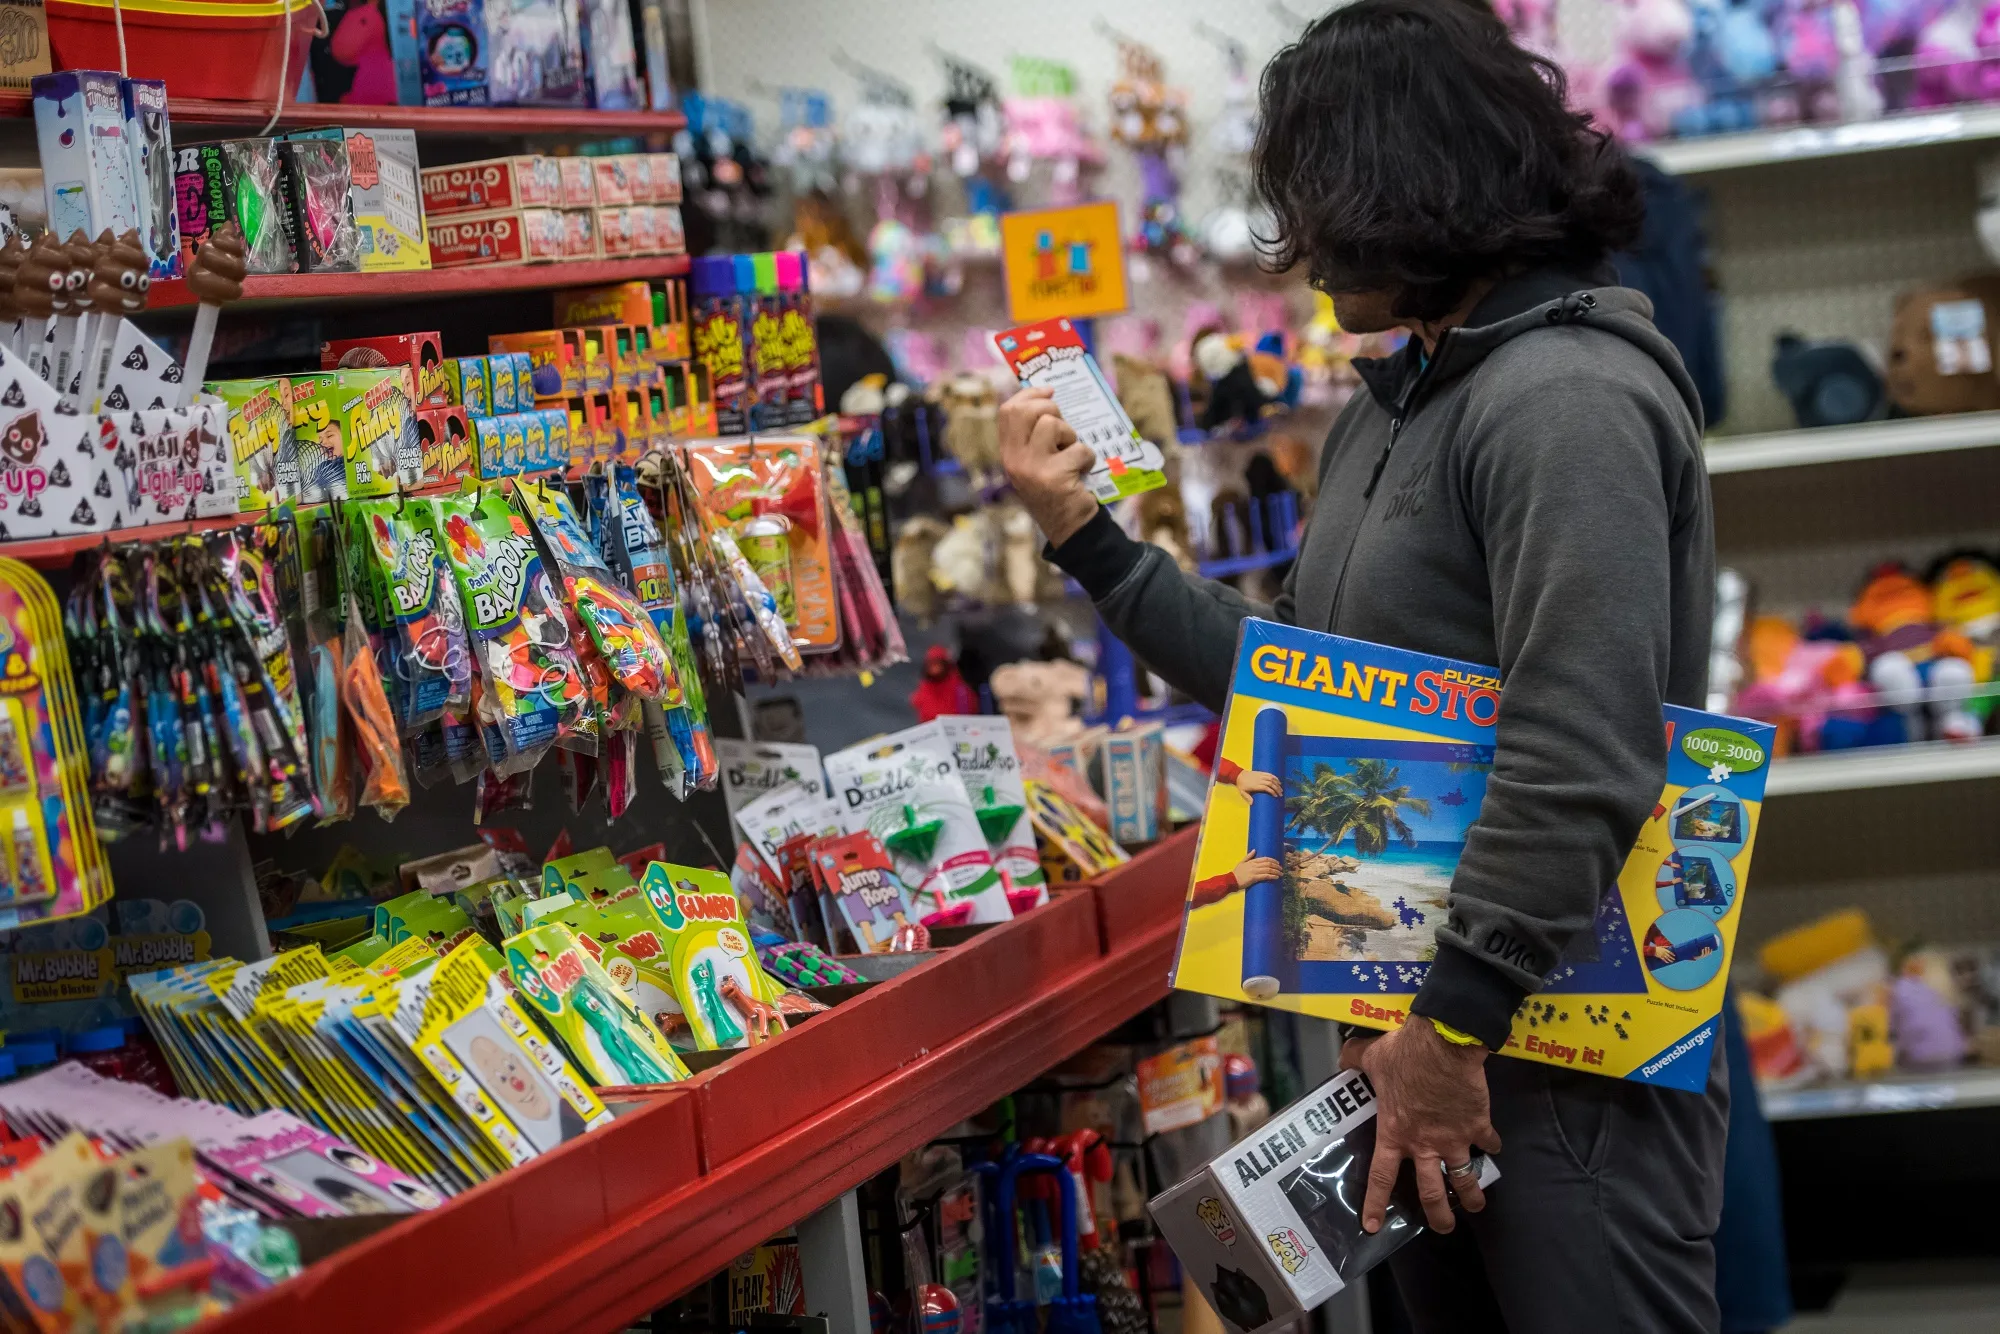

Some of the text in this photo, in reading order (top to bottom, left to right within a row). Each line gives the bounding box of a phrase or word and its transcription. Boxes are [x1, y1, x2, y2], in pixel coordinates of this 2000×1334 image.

[202, 147, 219, 157] The
[1015, 345, 1085, 380] Jump Rope
[322, 379, 332, 387] 5+
[342, 395, 363, 413] ORIGINAL
[347, 404, 400, 462] Slinky
[277, 461, 298, 473] GRAND
[355, 462, 367, 473] BIG
[356, 472, 371, 484] FUN!
[414, 508, 428, 518] 8+
[394, 528, 436, 611] BALLOONS
[468, 569, 491, 590] Party
[1250, 644, 1500, 727] GIANT STO
[1444, 669, 1503, 691] PUZZL
[838, 868, 881, 894] Jump
[677, 895, 737, 921] GUMBY
[860, 885, 899, 908] Rope
[540, 950, 586, 995] GUMBY
[1646, 998, 1699, 1014] Puzzle Not Included
[1525, 1034, 1578, 1064] Enjoy
[1582, 1045, 1605, 1066] it!
[1642, 1027, 1712, 1078] Ravensburger
[1234, 1121, 1307, 1189] ALIEN
[732, 1273, 765, 1310] X-RAY
